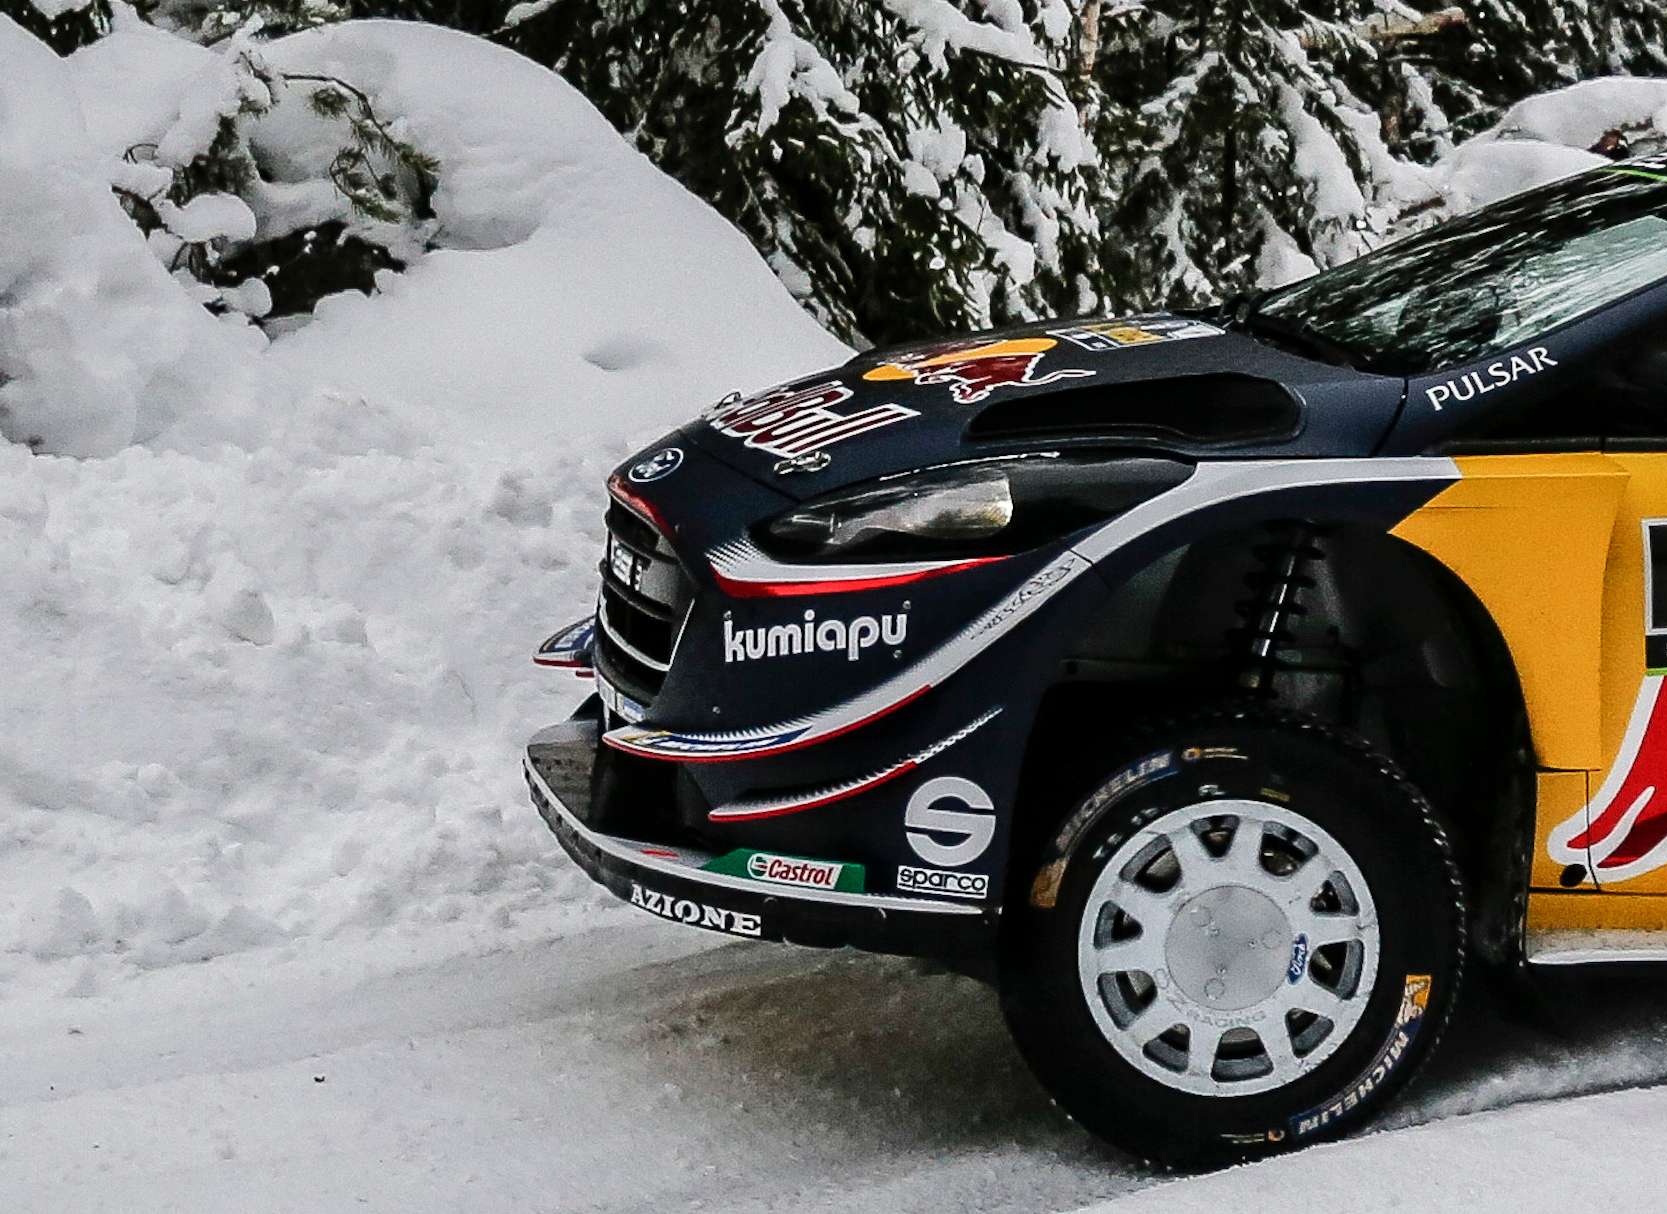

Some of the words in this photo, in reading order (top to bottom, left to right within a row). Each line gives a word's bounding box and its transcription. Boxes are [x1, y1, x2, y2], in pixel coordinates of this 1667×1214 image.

[1425, 345, 1559, 412] PULSAR
[723, 608, 908, 663] kumiapu
[768, 859, 834, 886] Castrol
[899, 867, 987, 892] sparco
[630, 883, 762, 936] AZIONE
[1298, 1030, 1410, 1135] MICHELIN
